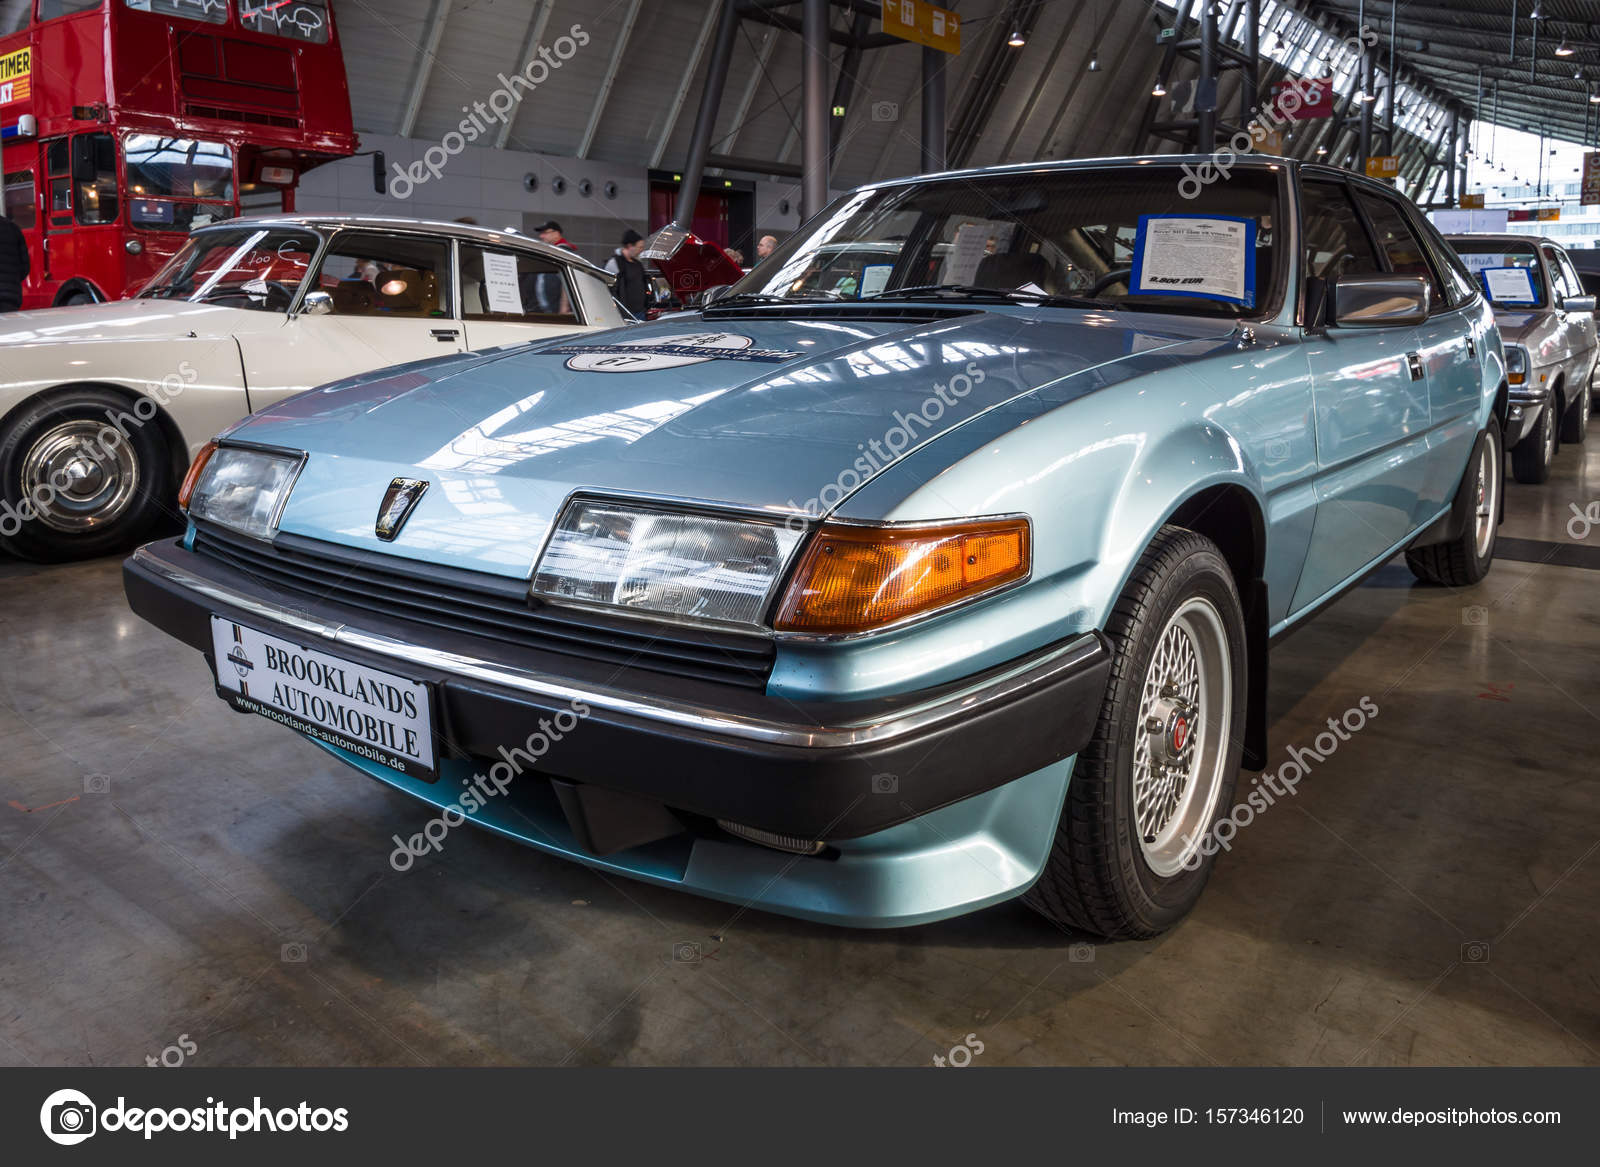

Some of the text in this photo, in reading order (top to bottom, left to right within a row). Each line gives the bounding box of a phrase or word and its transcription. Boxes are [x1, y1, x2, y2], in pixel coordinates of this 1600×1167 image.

[595, 356, 648, 367] 67
[264, 643, 418, 720] BROOKLANDS
[272, 681, 421, 758] AUTOMOBILE
[236, 695, 406, 772] www.brooklands-automobile.de
